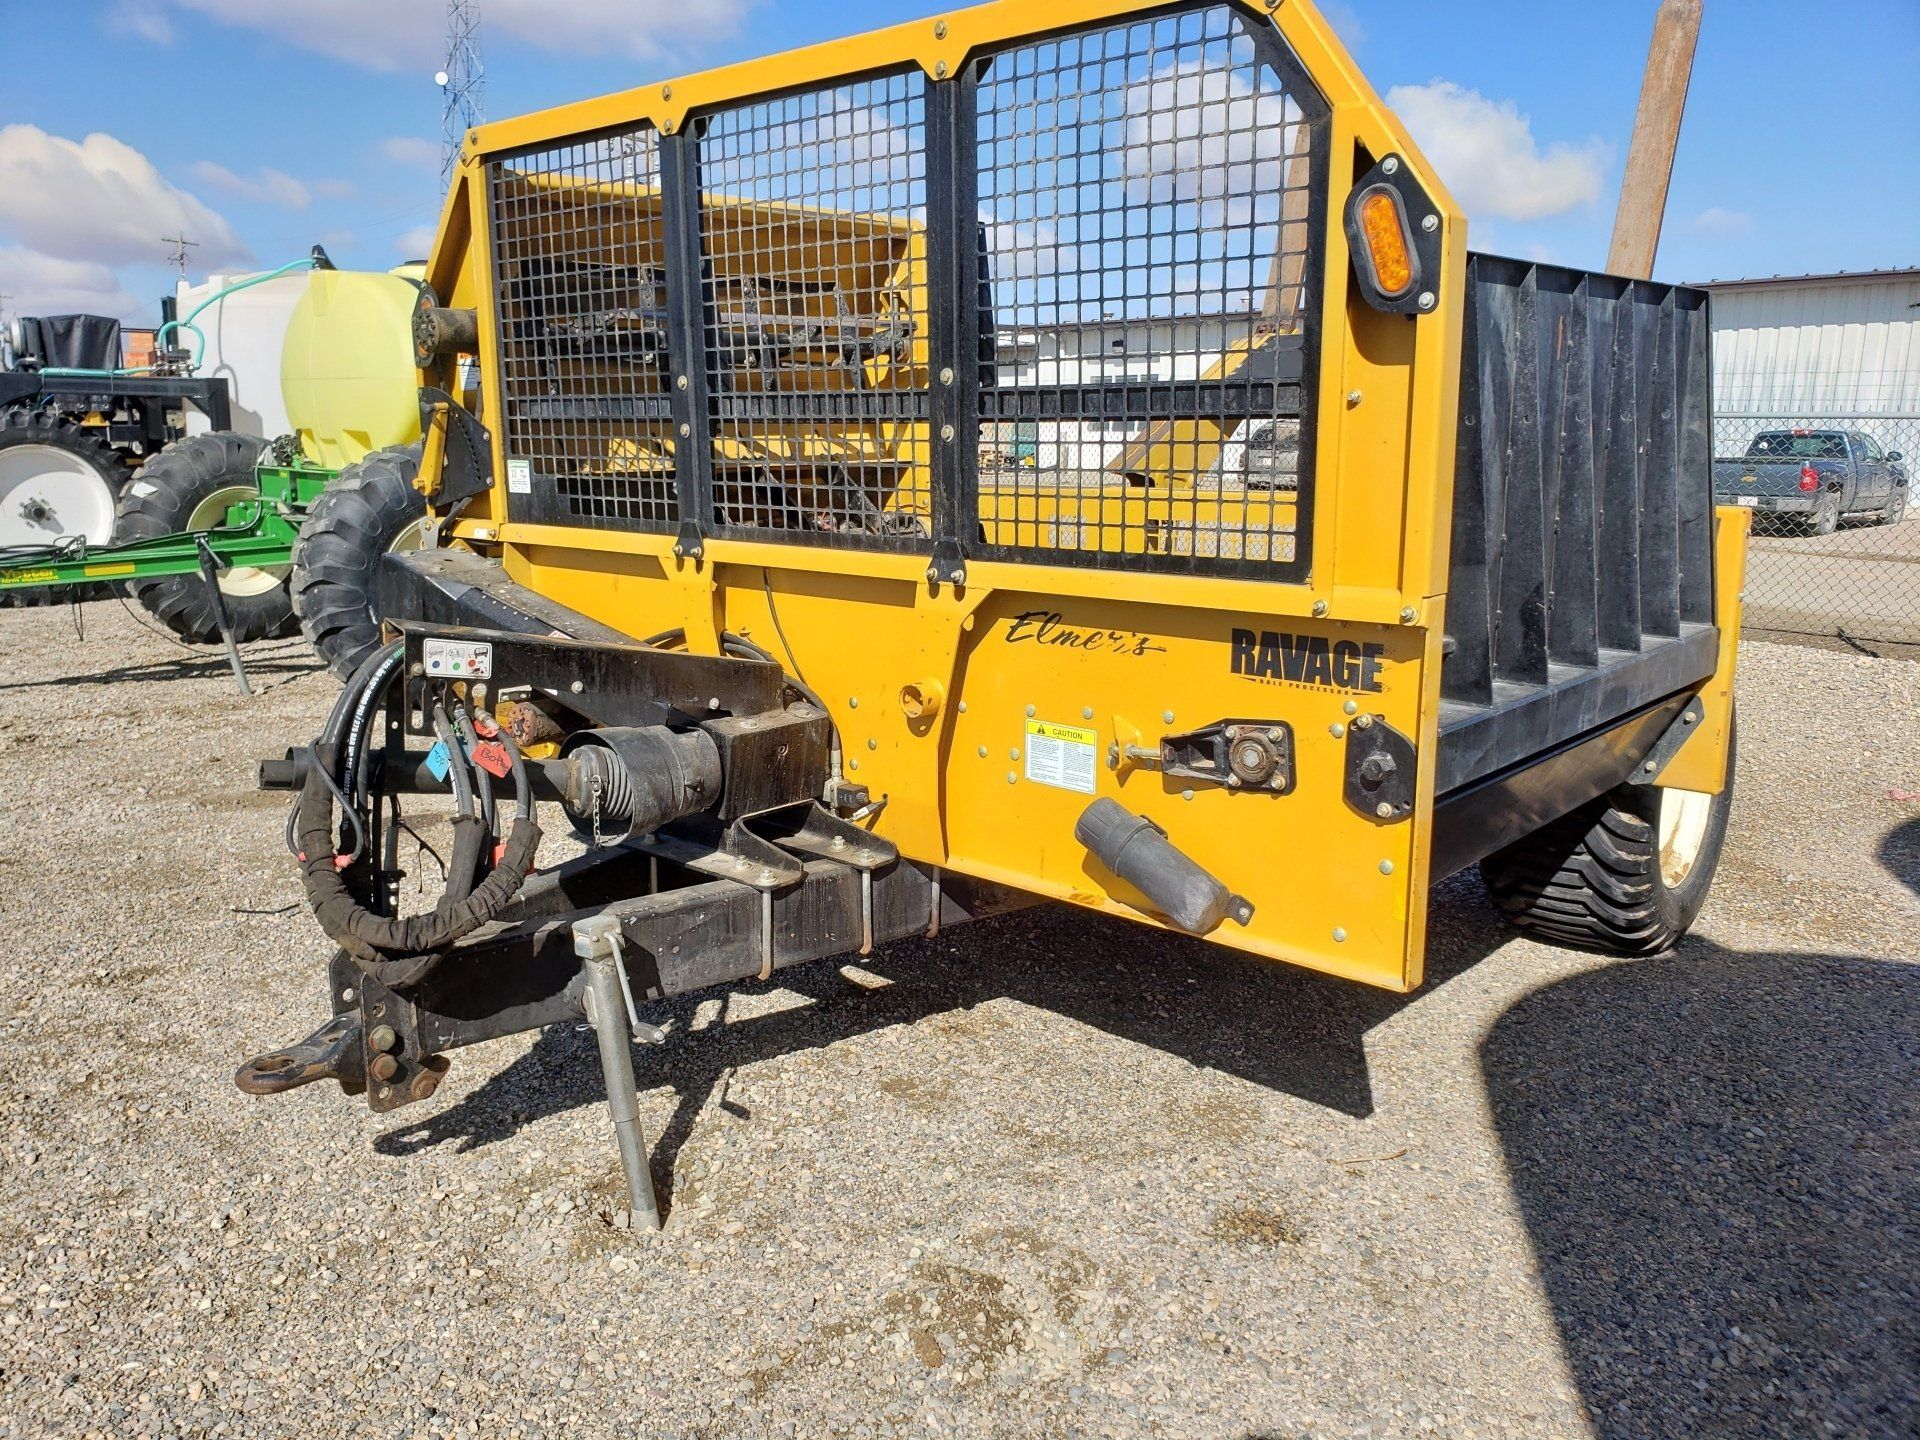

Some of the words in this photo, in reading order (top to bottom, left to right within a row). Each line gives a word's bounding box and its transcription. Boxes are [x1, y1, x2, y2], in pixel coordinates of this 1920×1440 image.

[1231, 628, 1385, 693] RAVAGE
[1259, 679, 1283, 687] BALE
[1288, 683, 1350, 695] PROCESSOR
[1052, 728, 1083, 740] CAUTION
[434, 749, 445, 768] TOP
